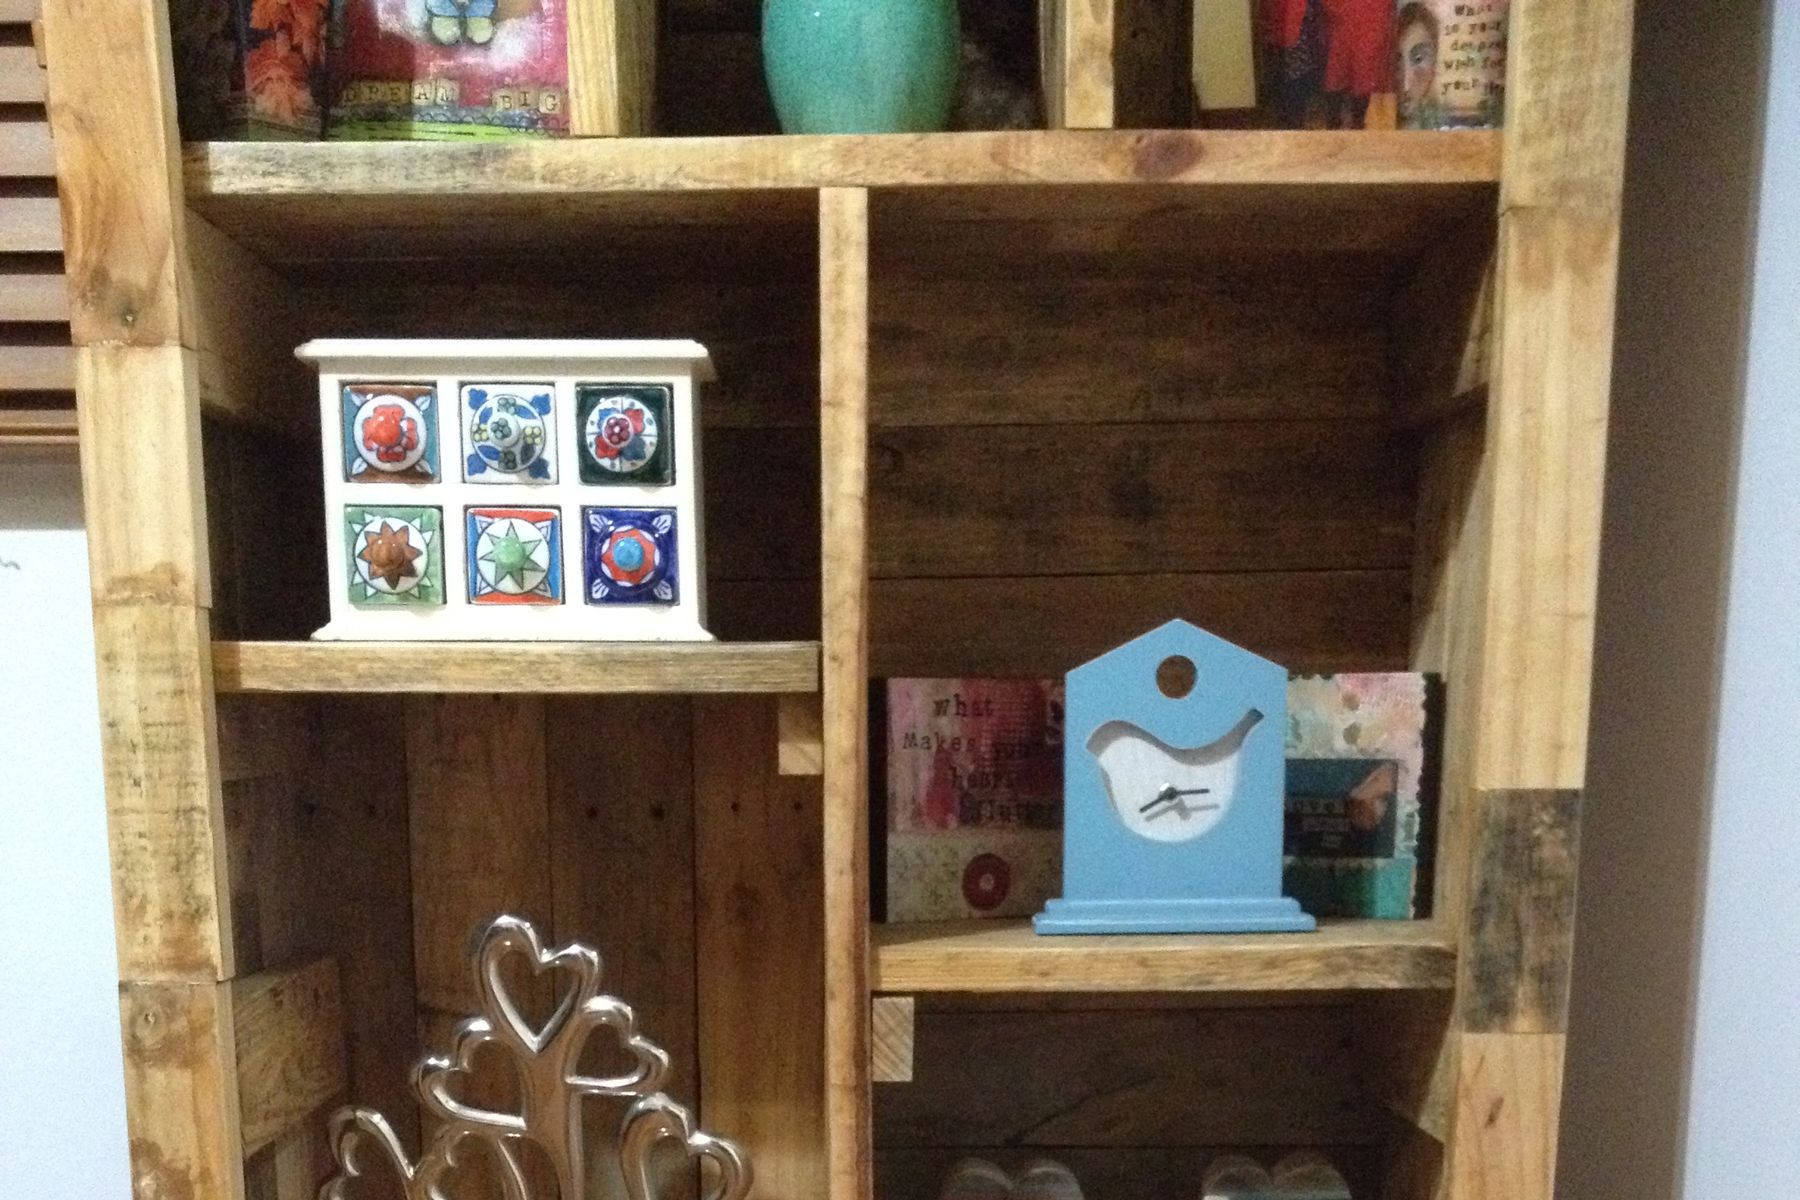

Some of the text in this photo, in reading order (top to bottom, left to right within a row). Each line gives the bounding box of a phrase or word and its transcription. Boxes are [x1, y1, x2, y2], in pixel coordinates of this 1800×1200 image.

[344, 83, 559, 111] DREAM BIG
[902, 732, 977, 752] Makes
